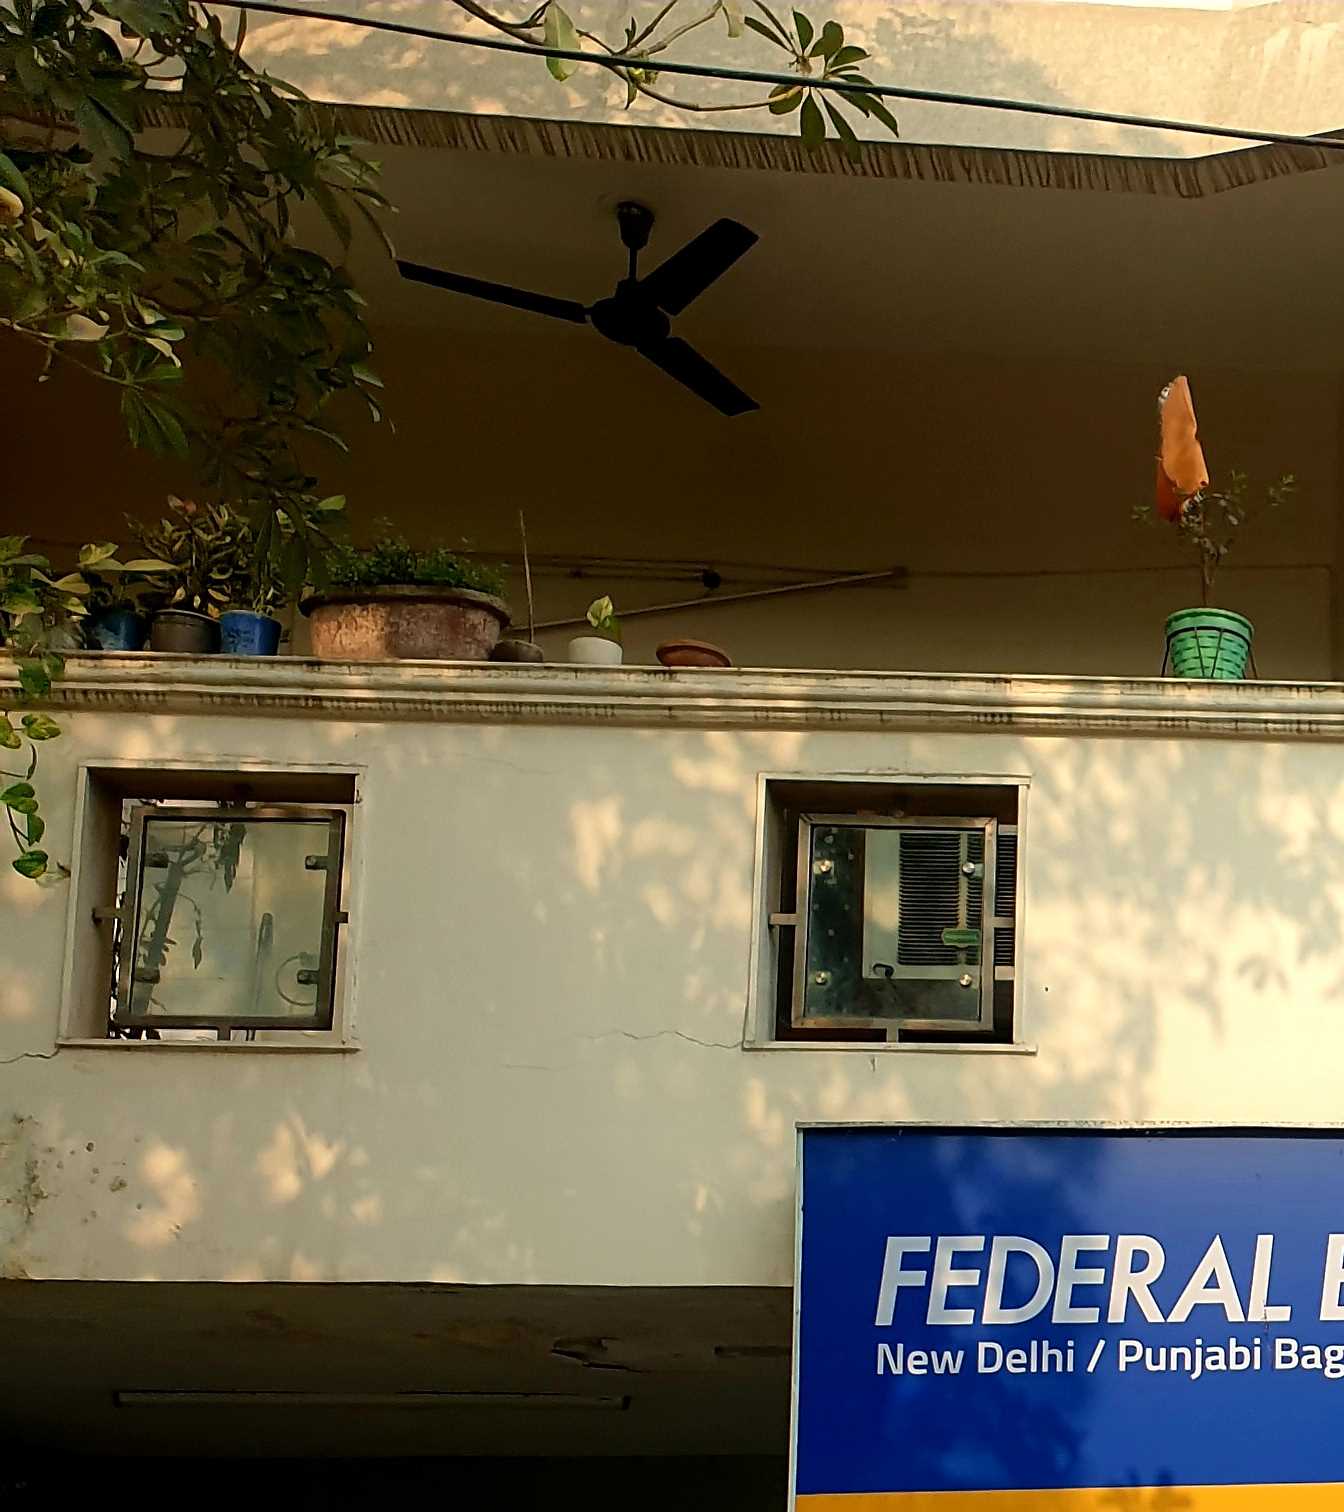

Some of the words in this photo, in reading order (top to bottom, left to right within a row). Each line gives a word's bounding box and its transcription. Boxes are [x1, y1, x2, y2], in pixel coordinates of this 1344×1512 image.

[875, 1233, 1291, 1326] FEDERAL
[876, 1342, 962, 1375] New
[977, 1339, 1074, 1374] Delhi
[1087, 1339, 1106, 1374] /
[1119, 1335, 1262, 1380] Punjabi
